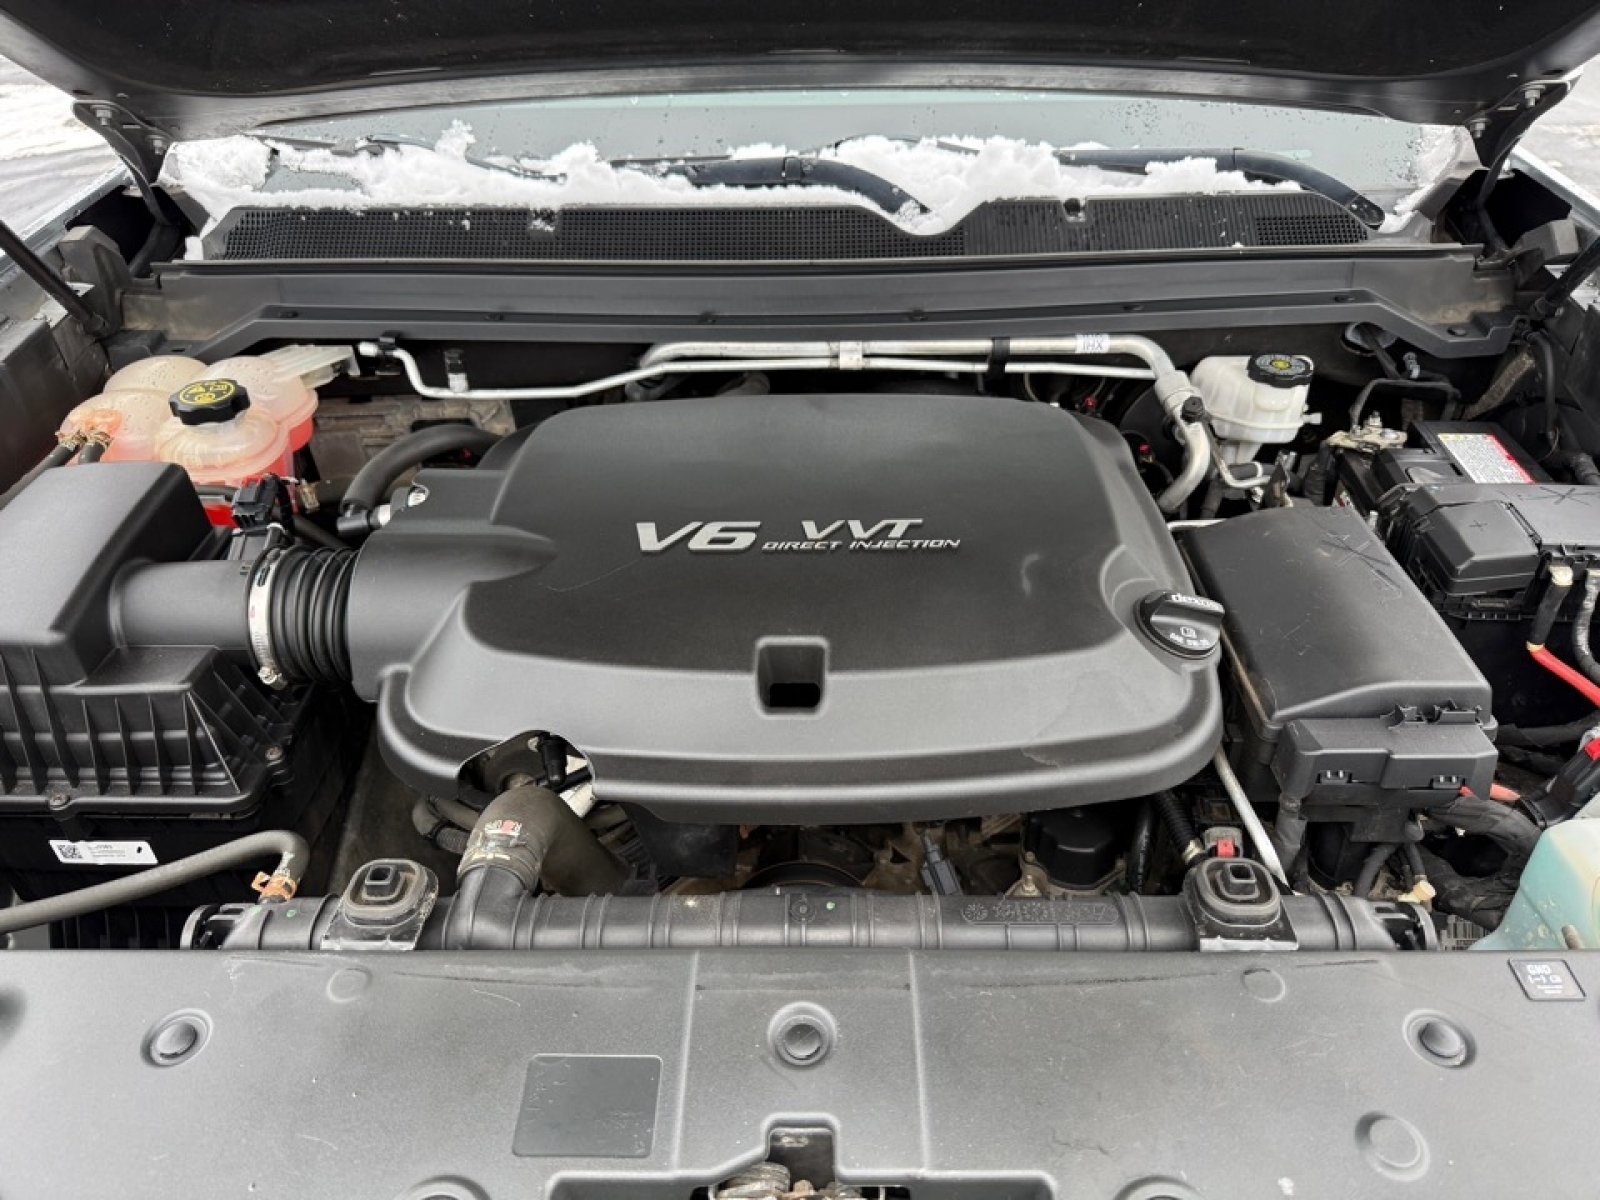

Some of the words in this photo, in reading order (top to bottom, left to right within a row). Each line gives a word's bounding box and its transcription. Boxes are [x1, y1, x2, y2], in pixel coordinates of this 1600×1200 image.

[636, 521, 761, 552] V6
[801, 518, 923, 540] VVT
[762, 540, 843, 551] DIRECT
[849, 538, 961, 550] INJECTION
